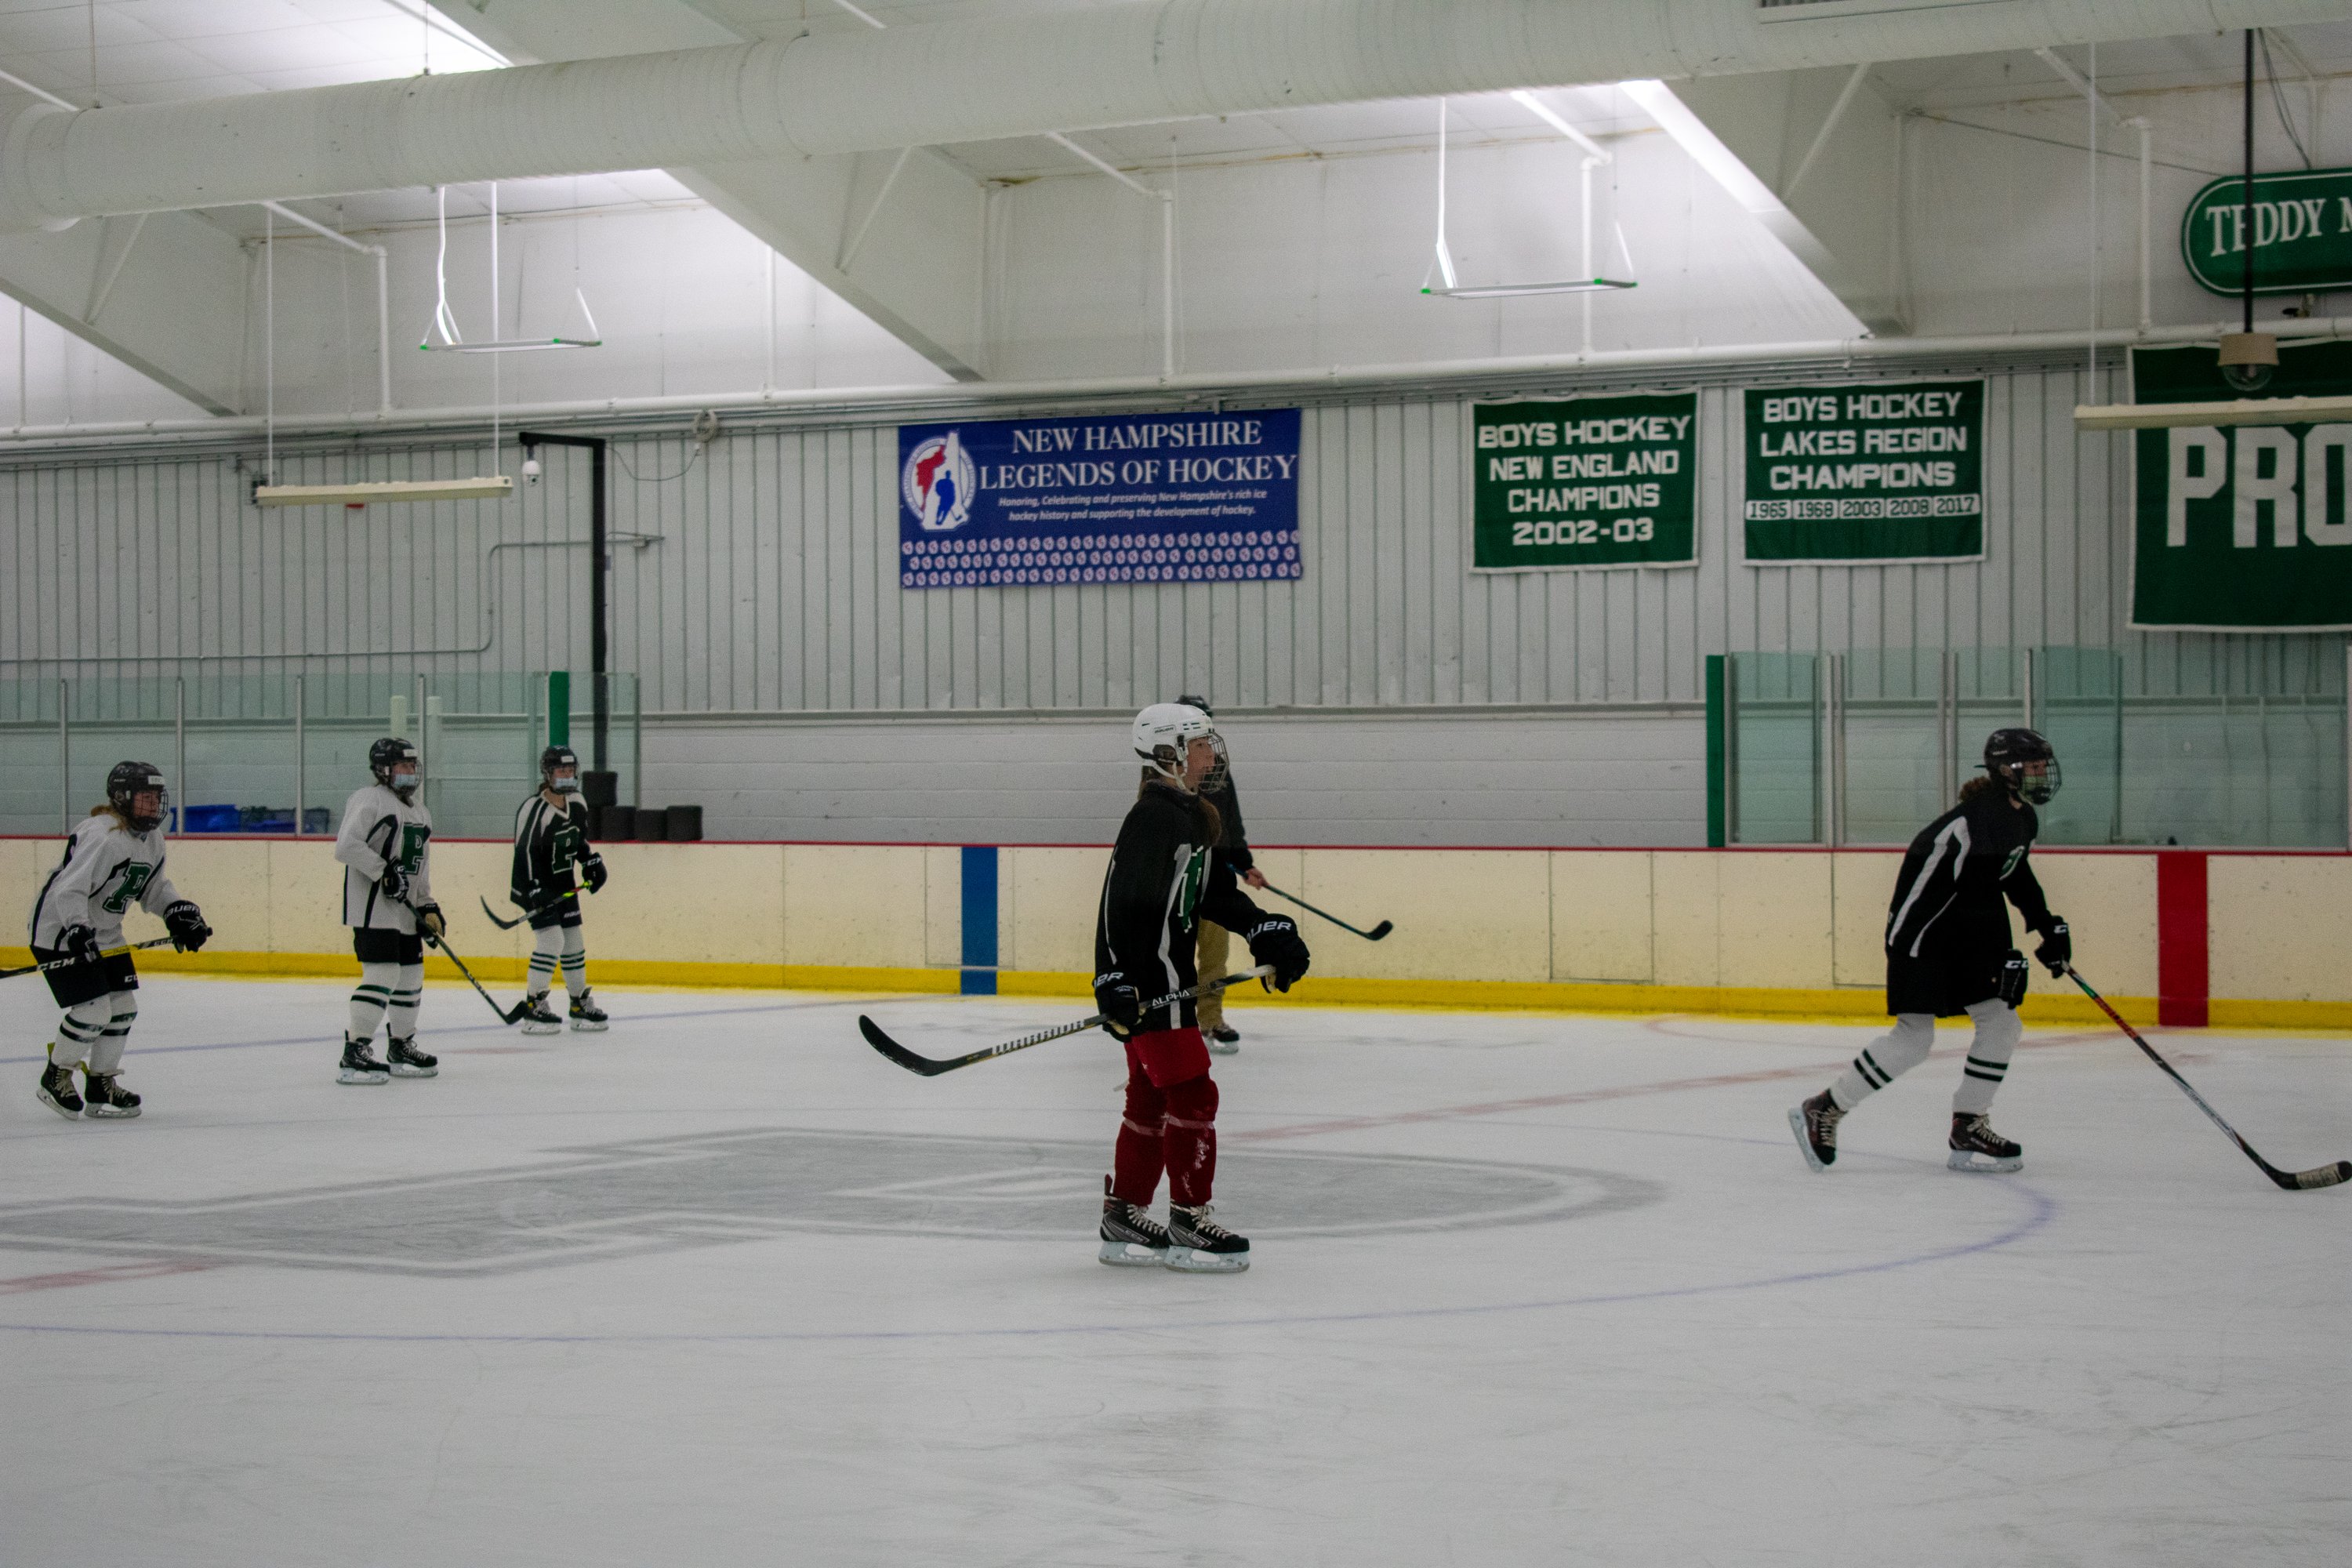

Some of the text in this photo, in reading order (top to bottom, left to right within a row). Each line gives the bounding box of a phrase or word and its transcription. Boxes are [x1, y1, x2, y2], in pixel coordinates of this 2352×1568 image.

[2205, 198, 2327, 257] TEDDY
[1763, 391, 1962, 423] BOYS HOCKEY
[1012, 420, 1262, 453] NEW HAMPSHIRE
[1478, 415, 1691, 448] BOYS HOCKEY
[1760, 426, 1967, 457] LAKES REGION
[980, 461, 1116, 490] LEGENDS
[1122, 459, 1161, 485] OF
[1168, 455, 1297, 483] HOCKEY
[1490, 449, 1679, 481] NEW ENGLAND
[1770, 461, 1956, 491] CHAMPIONS
[999, 497, 1040, 507] Honoring,
[1042, 495, 1091, 506] Celebrating
[1093, 494, 1110, 503] and
[1111, 493, 1156, 505] preserving
[1158, 492, 1177, 502] New
[1178, 490, 1234, 502] Hampshire's
[1235, 490, 1252, 499] rich
[1508, 483, 1661, 513] CHAMPIONS
[2167, 426, 2352, 547] PRO
[1008, 511, 1039, 522] hockey
[1040, 510, 1070, 521] history
[1071, 510, 1088, 520] and
[1089, 509, 1134, 520] supporting
[1137, 507, 1152, 517] the
[1153, 506, 1210, 518] development
[1210, 505, 1222, 517] of
[1750, 497, 1975, 518] 1965 1968 2003 2008 2017
[1512, 517, 1654, 546] 2002-03
[102, 862, 154, 914] P
[38, 957, 76, 971] CCM
[1152, 989, 1191, 1007] ALPHA
